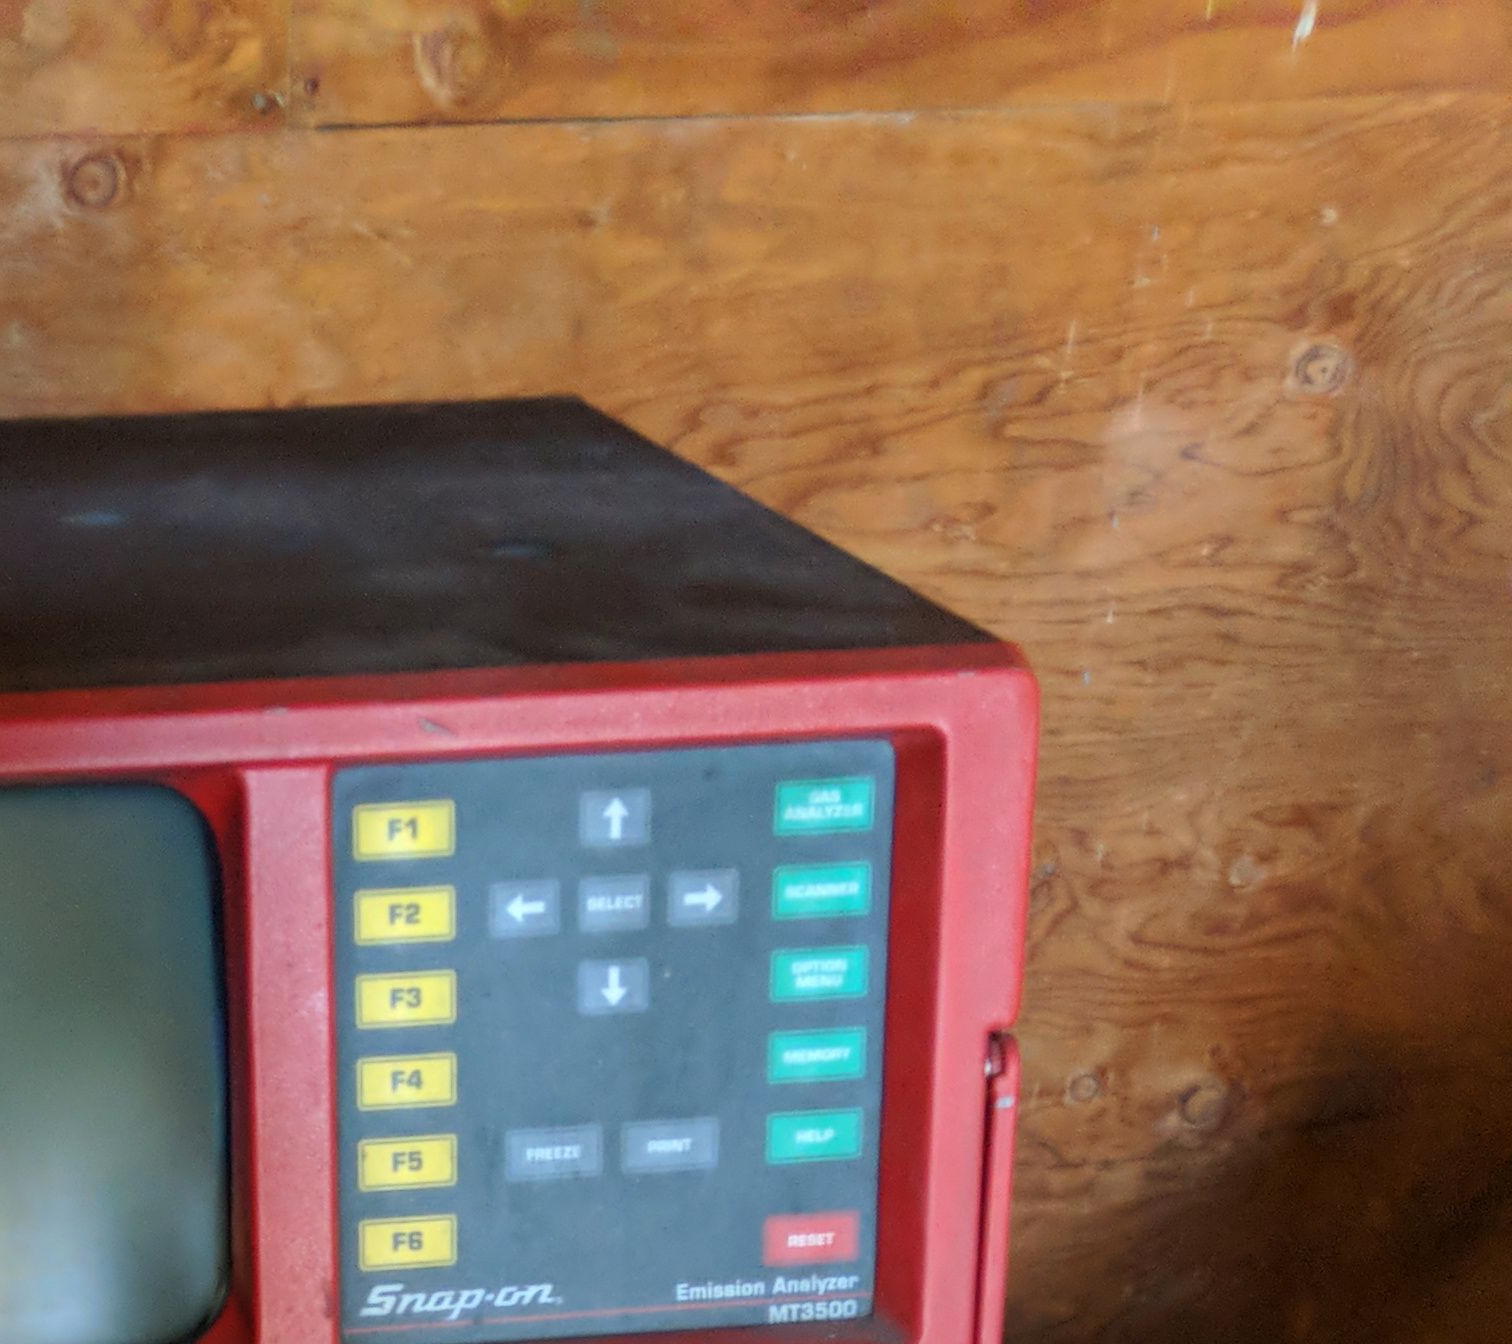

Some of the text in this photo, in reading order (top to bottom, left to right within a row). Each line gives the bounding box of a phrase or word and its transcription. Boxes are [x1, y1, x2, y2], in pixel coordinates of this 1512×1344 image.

[785, 803, 863, 819] ANALYZER
[388, 818, 418, 841] F1
[785, 882, 859, 898] SCANNER
[587, 895, 642, 911] SELECT
[388, 903, 422, 926] F2
[792, 959, 847, 975] OPTION
[795, 975, 843, 988] MENU
[389, 987, 423, 1009] F3
[783, 1047, 851, 1063] MEMORY
[390, 1069, 423, 1092] F4
[796, 1129, 834, 1144] HELP
[525, 1145, 582, 1162] FREEZE
[646, 1138, 693, 1154] PRINT
[391, 1151, 424, 1173] F5
[392, 1231, 424, 1252] F6
[787, 1232, 836, 1249] RESET
[676, 1273, 859, 1301] Emission Analyzer
[359, 1283, 555, 1321] Snap-on
[768, 1299, 858, 1324] MT3500
